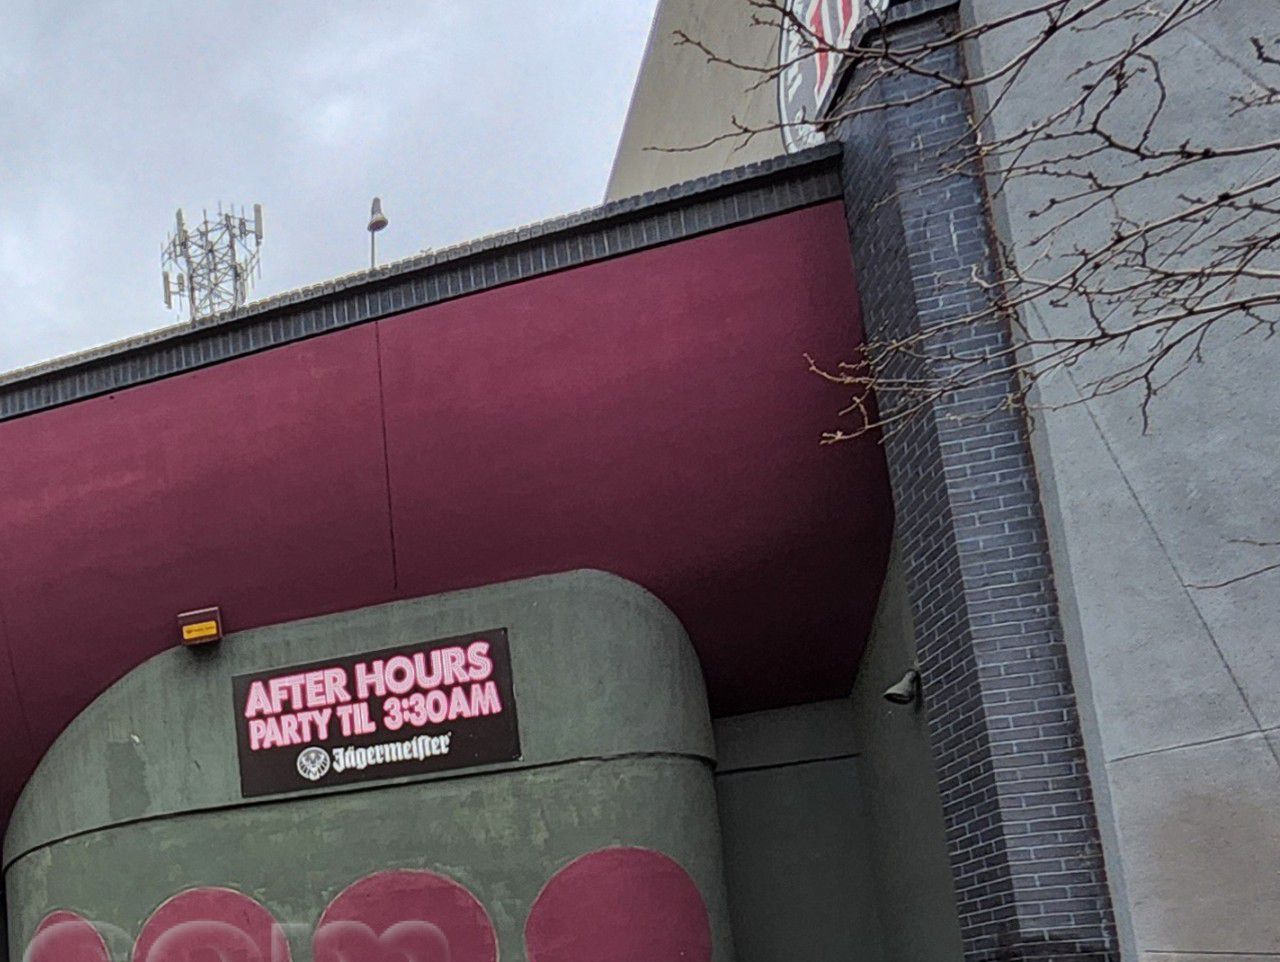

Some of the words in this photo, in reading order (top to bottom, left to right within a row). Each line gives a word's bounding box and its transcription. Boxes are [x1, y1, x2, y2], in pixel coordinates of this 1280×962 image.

[245, 667, 352, 718] AFTER
[355, 641, 493, 699] HOURS
[248, 708, 332, 750] PARTY
[336, 702, 377, 737] TIL
[384, 681, 502, 730] 3:30AM
